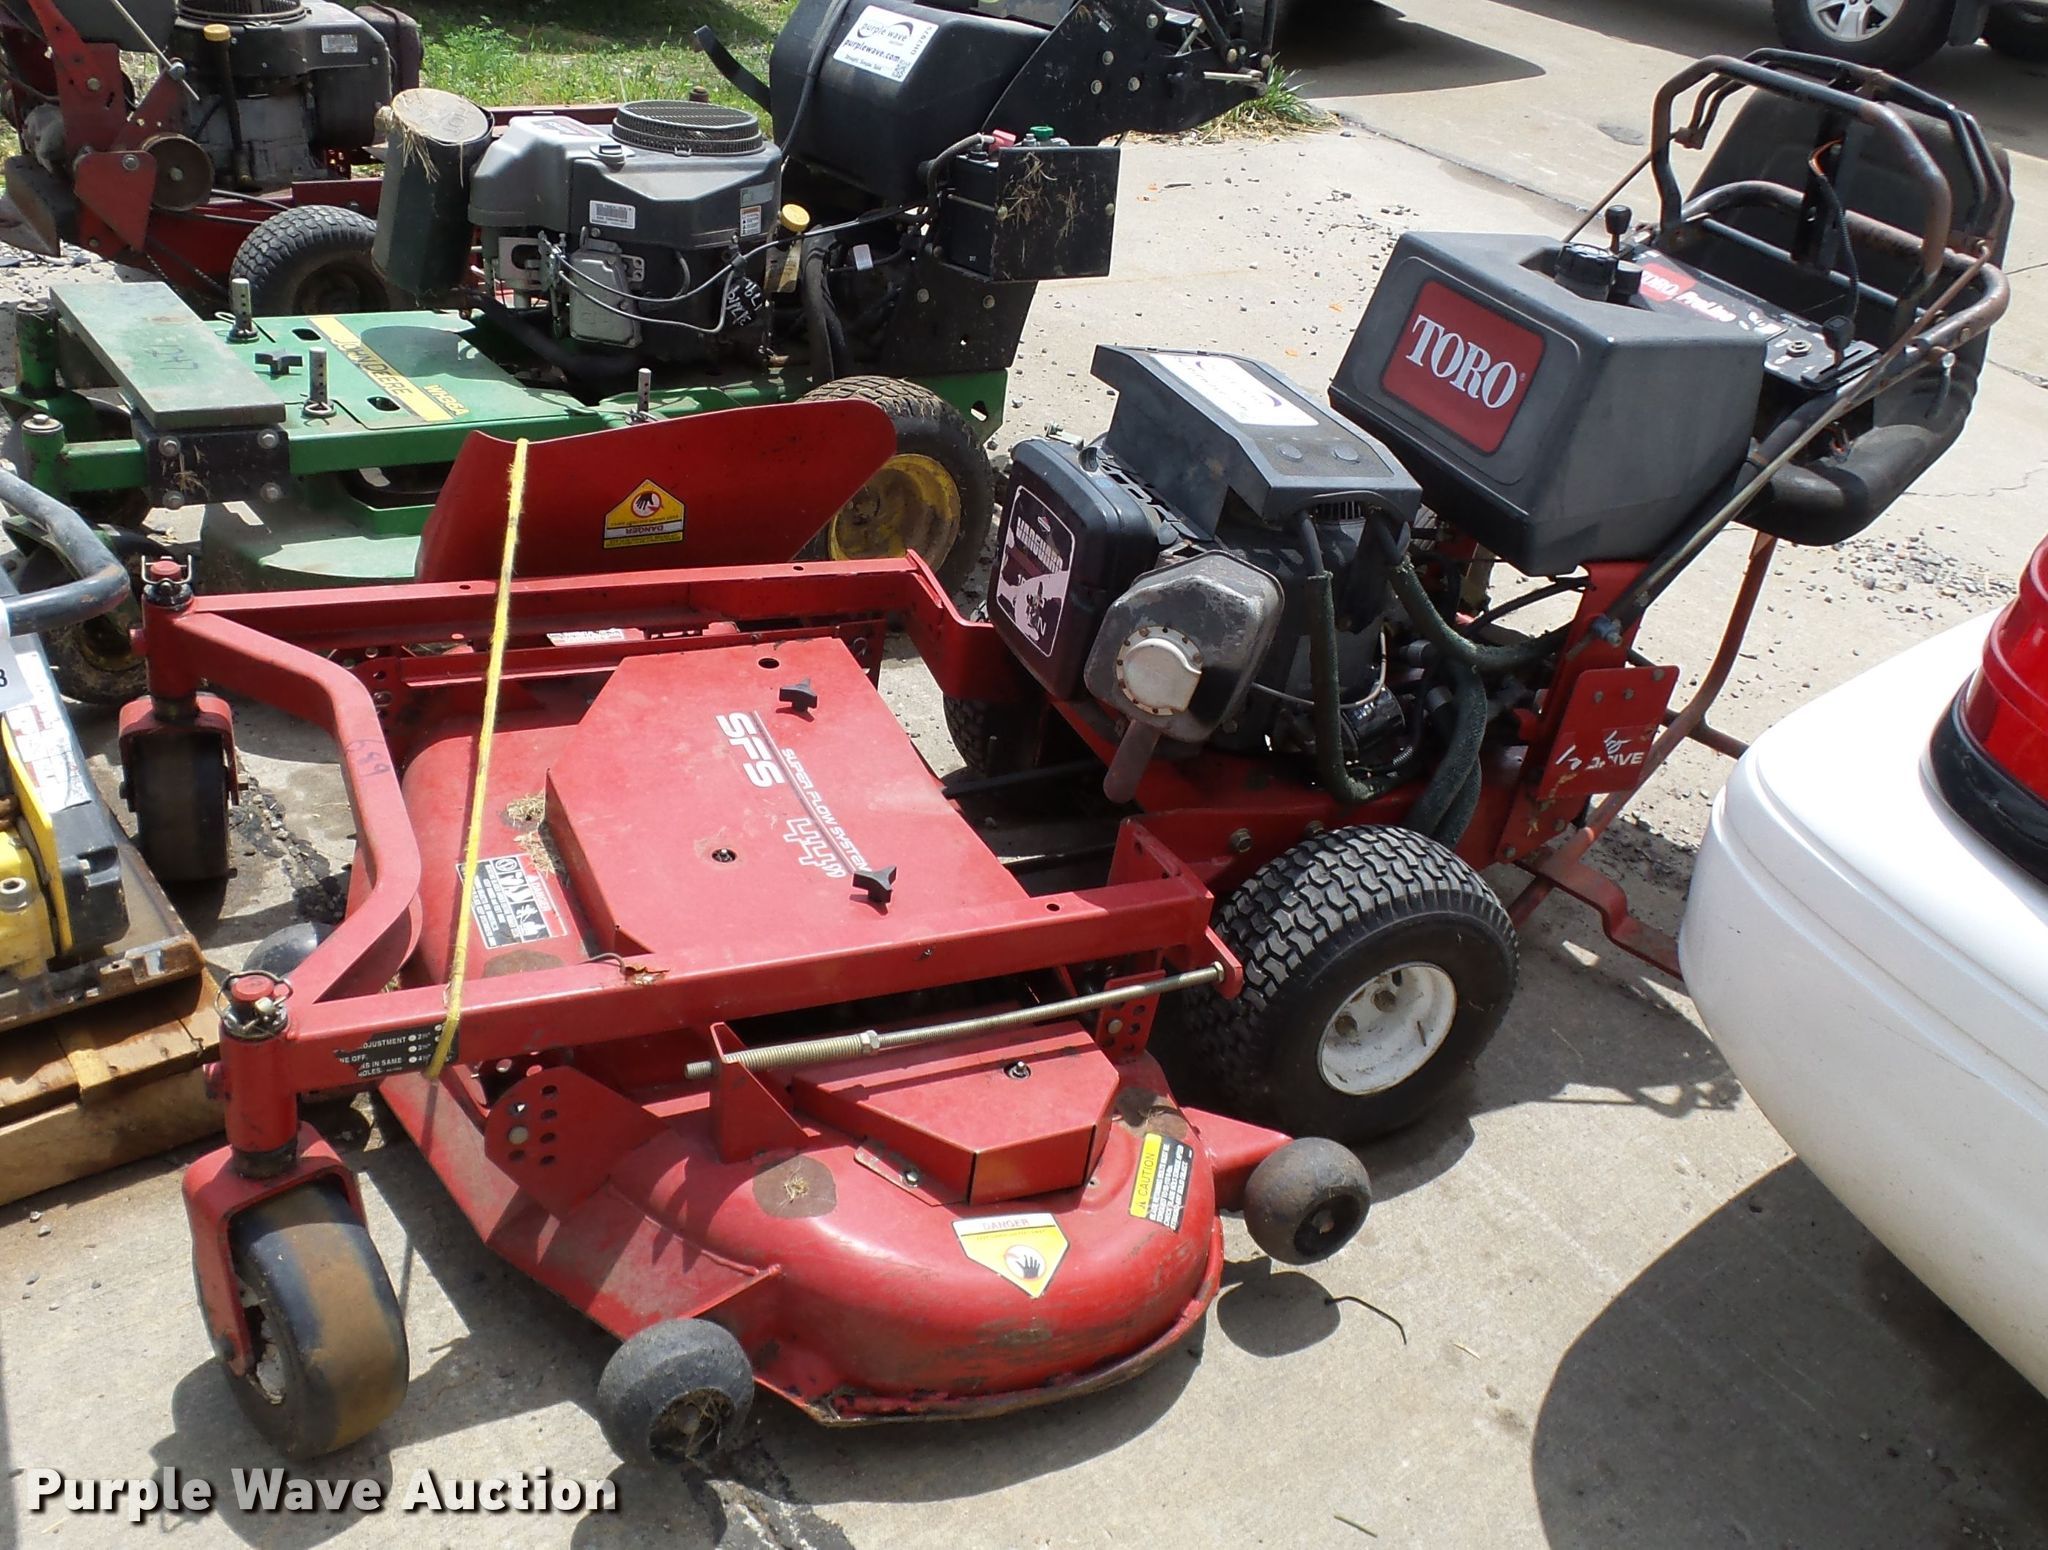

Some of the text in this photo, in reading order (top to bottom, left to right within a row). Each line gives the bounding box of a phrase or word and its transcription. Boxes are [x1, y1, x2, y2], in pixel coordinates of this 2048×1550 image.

[842, 39, 900, 62] purplewave.com
[333, 338, 413, 395] JOHN DEERE
[1406, 314, 1517, 409] TORO
[625, 525, 664, 535] DANGER
[1016, 516, 1063, 575] VANGUARD
[716, 712, 785, 788] SFS
[782, 748, 813, 790] SUPER
[806, 791, 838, 825] FLOW
[360, 1036, 406, 1049] DJUSTMENT
[381, 1057, 402, 1066] SAME
[1138, 1152, 1154, 1197] CAUTION
[982, 1218, 1029, 1230] DANGER
